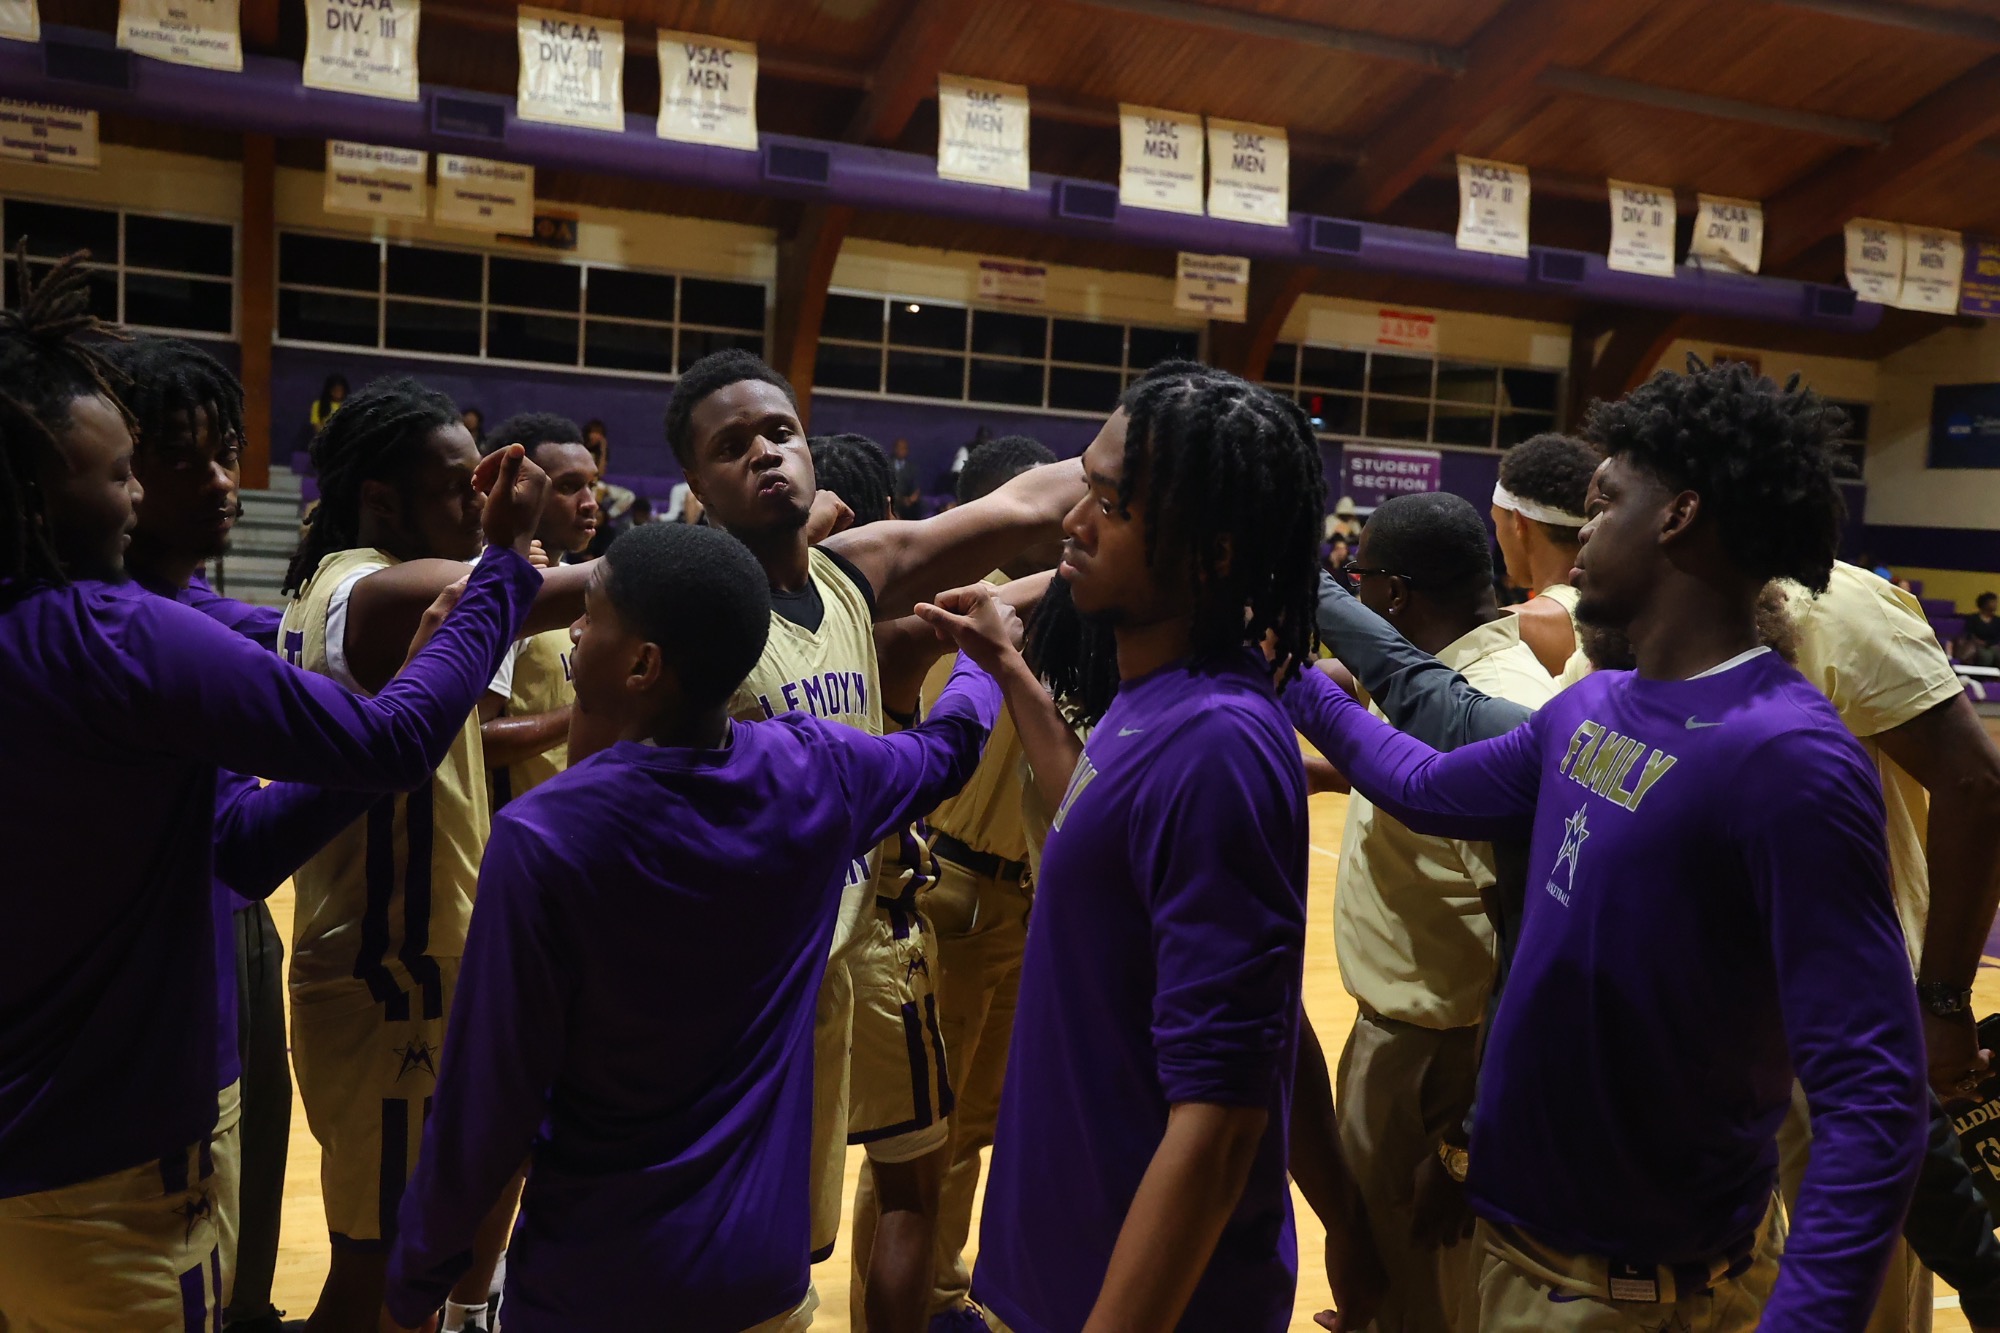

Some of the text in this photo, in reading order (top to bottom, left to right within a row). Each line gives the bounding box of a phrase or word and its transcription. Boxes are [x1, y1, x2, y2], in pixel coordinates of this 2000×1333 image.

[326, 8, 396, 39] DIV. III
[541, 19, 600, 42] NCAA
[684, 43, 732, 68] VSAC
[687, 69, 729, 91] MEN
[966, 112, 1004, 134] MEN
[1144, 118, 1179, 139] SIAC
[1143, 139, 1179, 160] MEN
[1232, 132, 1266, 152] SIAC
[1231, 153, 1267, 174] MEN
[1351, 457, 1431, 475] STUDENT
[1352, 474, 1428, 491] SECTION
[1559, 719, 1678, 813] FAMILY
